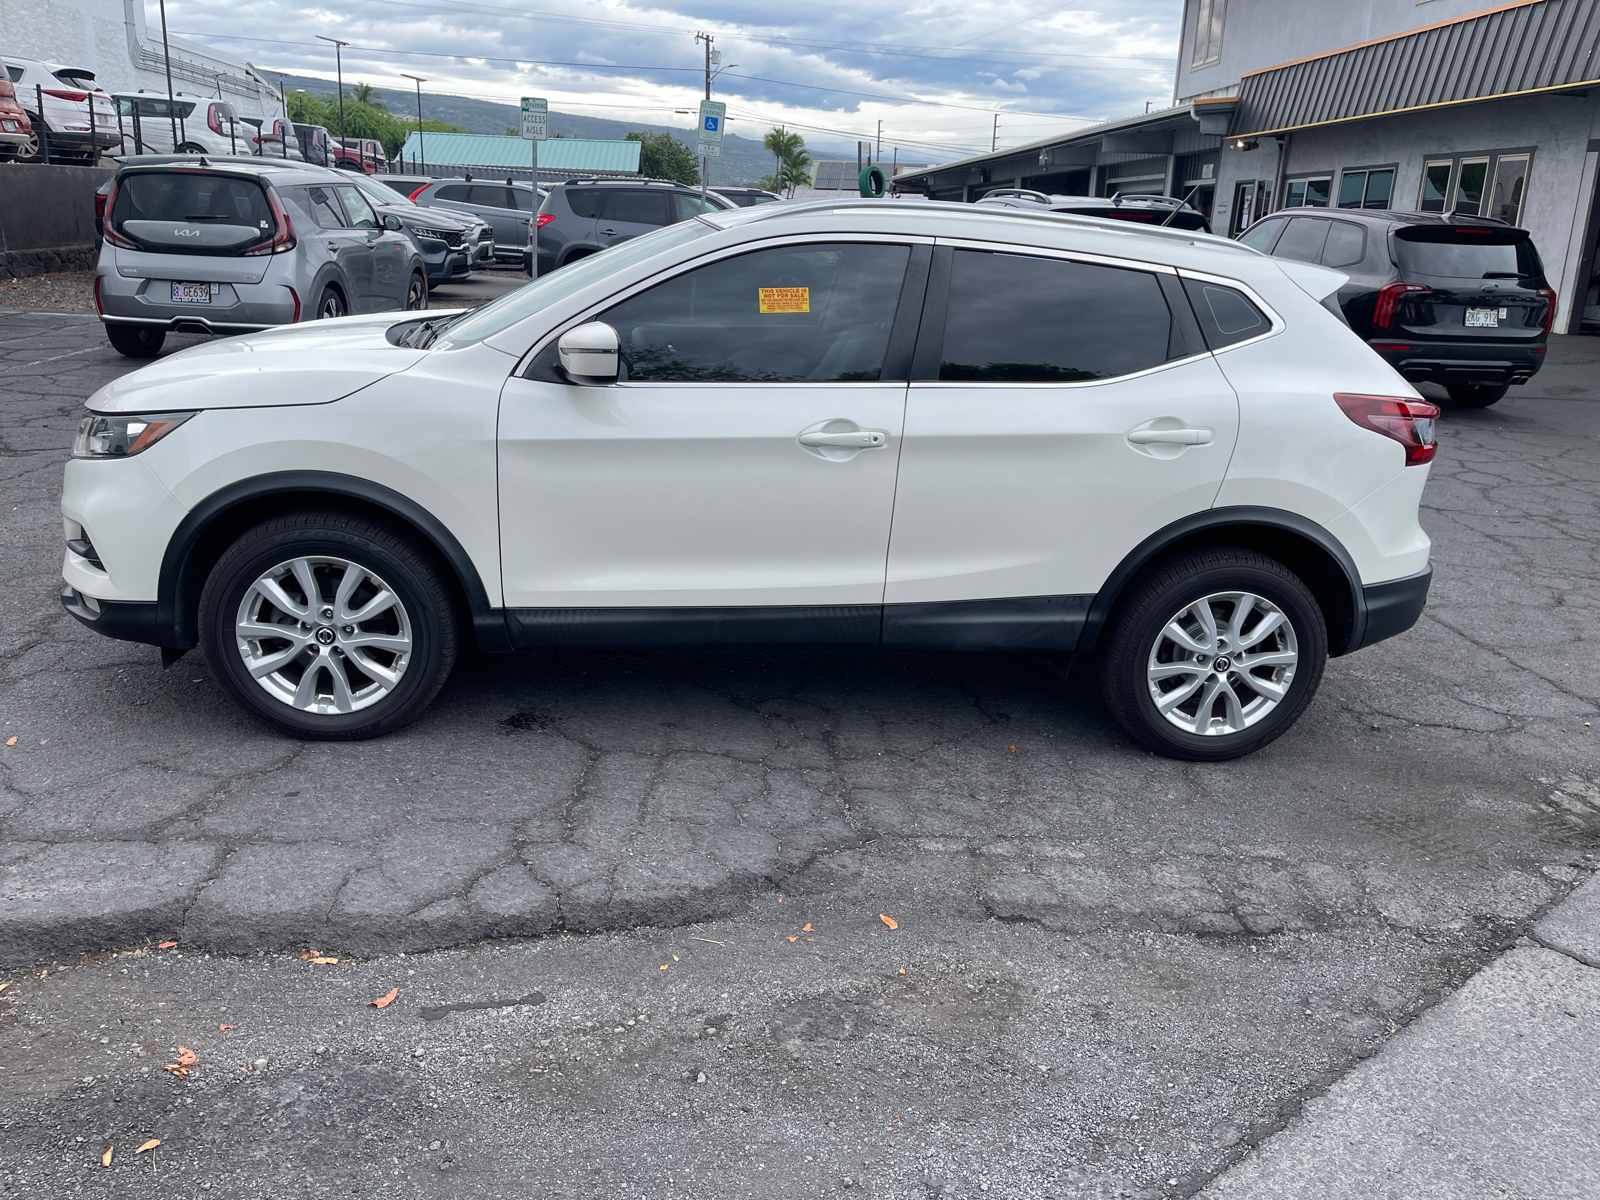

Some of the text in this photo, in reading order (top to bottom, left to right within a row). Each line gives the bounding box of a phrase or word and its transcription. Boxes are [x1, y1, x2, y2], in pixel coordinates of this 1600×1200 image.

[521, 100, 529, 109] NO
[702, 103, 724, 111] RESERVED
[703, 108, 722, 116] PARKING
[524, 114, 546, 124] ACCESS
[526, 126, 543, 134] AISLE
[174, 229, 200, 237] KIA
[184, 286, 208, 298] GE639
